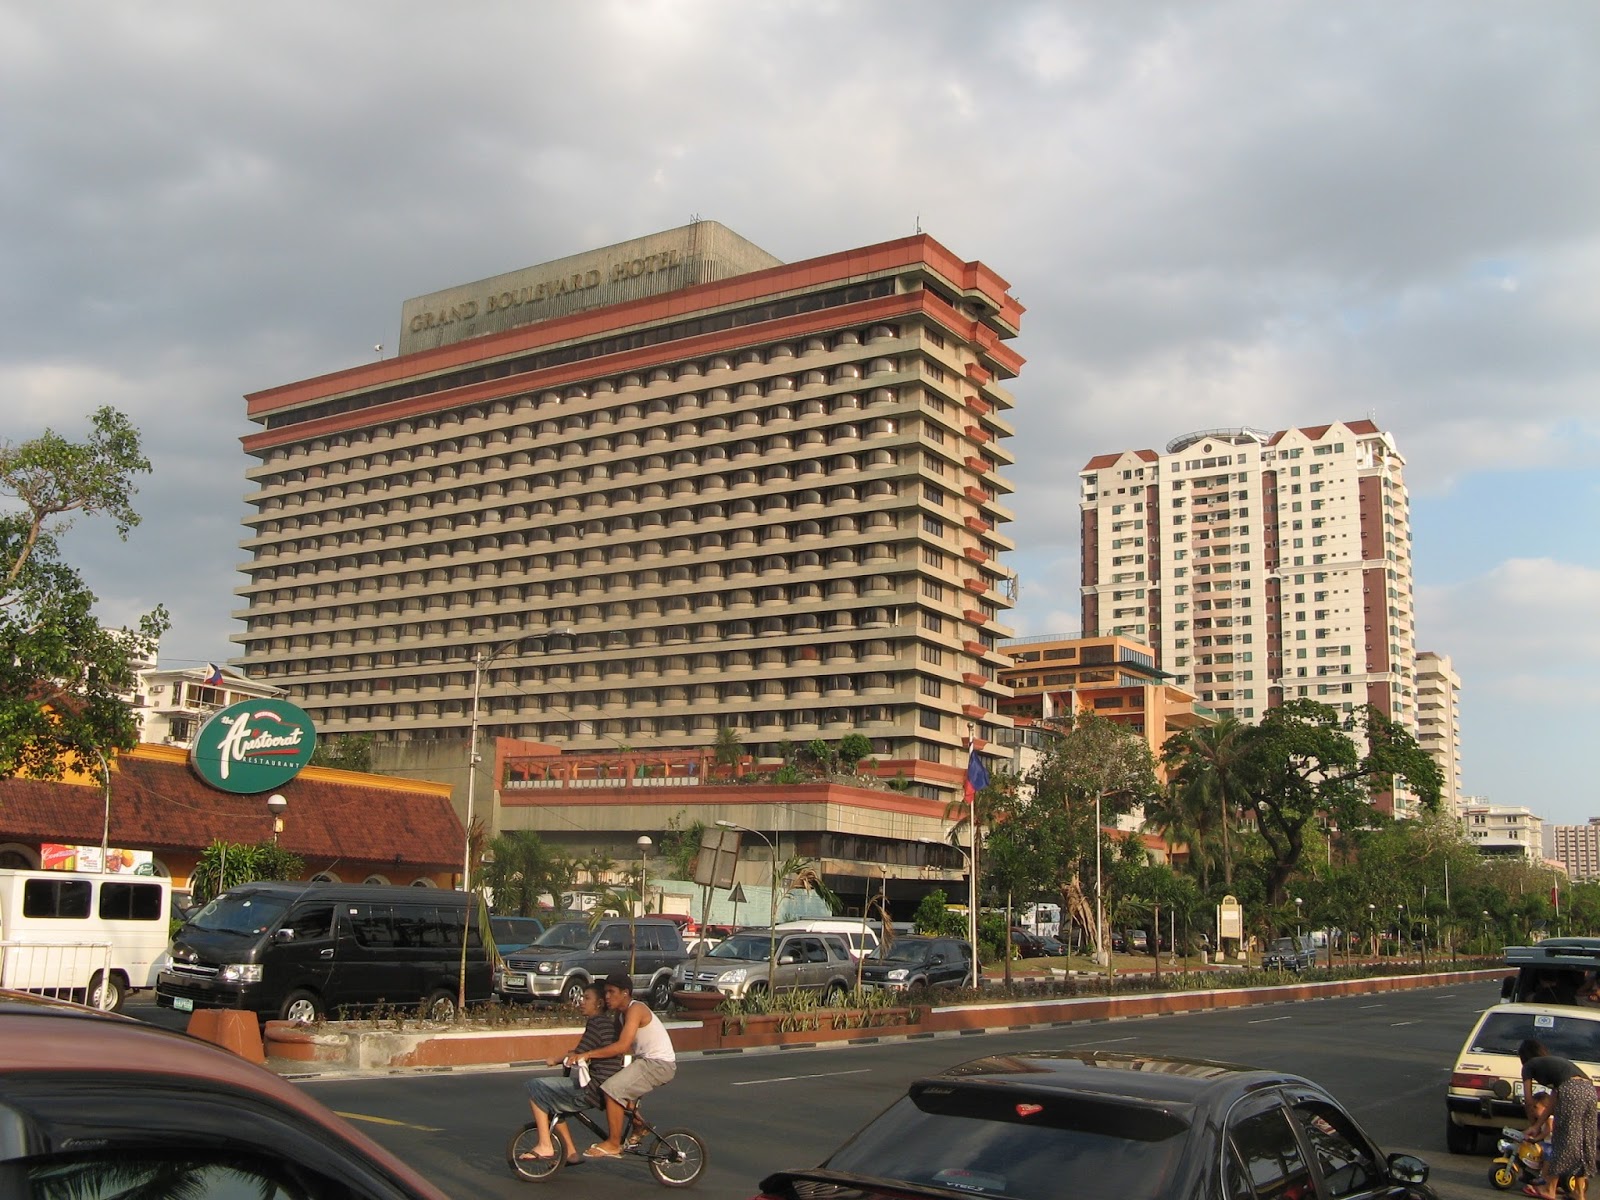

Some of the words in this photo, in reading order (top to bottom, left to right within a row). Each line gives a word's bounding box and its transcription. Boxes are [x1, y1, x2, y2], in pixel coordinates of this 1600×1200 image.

[410, 301, 478, 332] GRAND
[487, 269, 601, 313] BOULEVARD
[612, 250, 682, 282] HOTEL
[221, 716, 235, 726] the
[217, 712, 303, 780] Aristocrat
[243, 757, 300, 768] RESTAURANT
